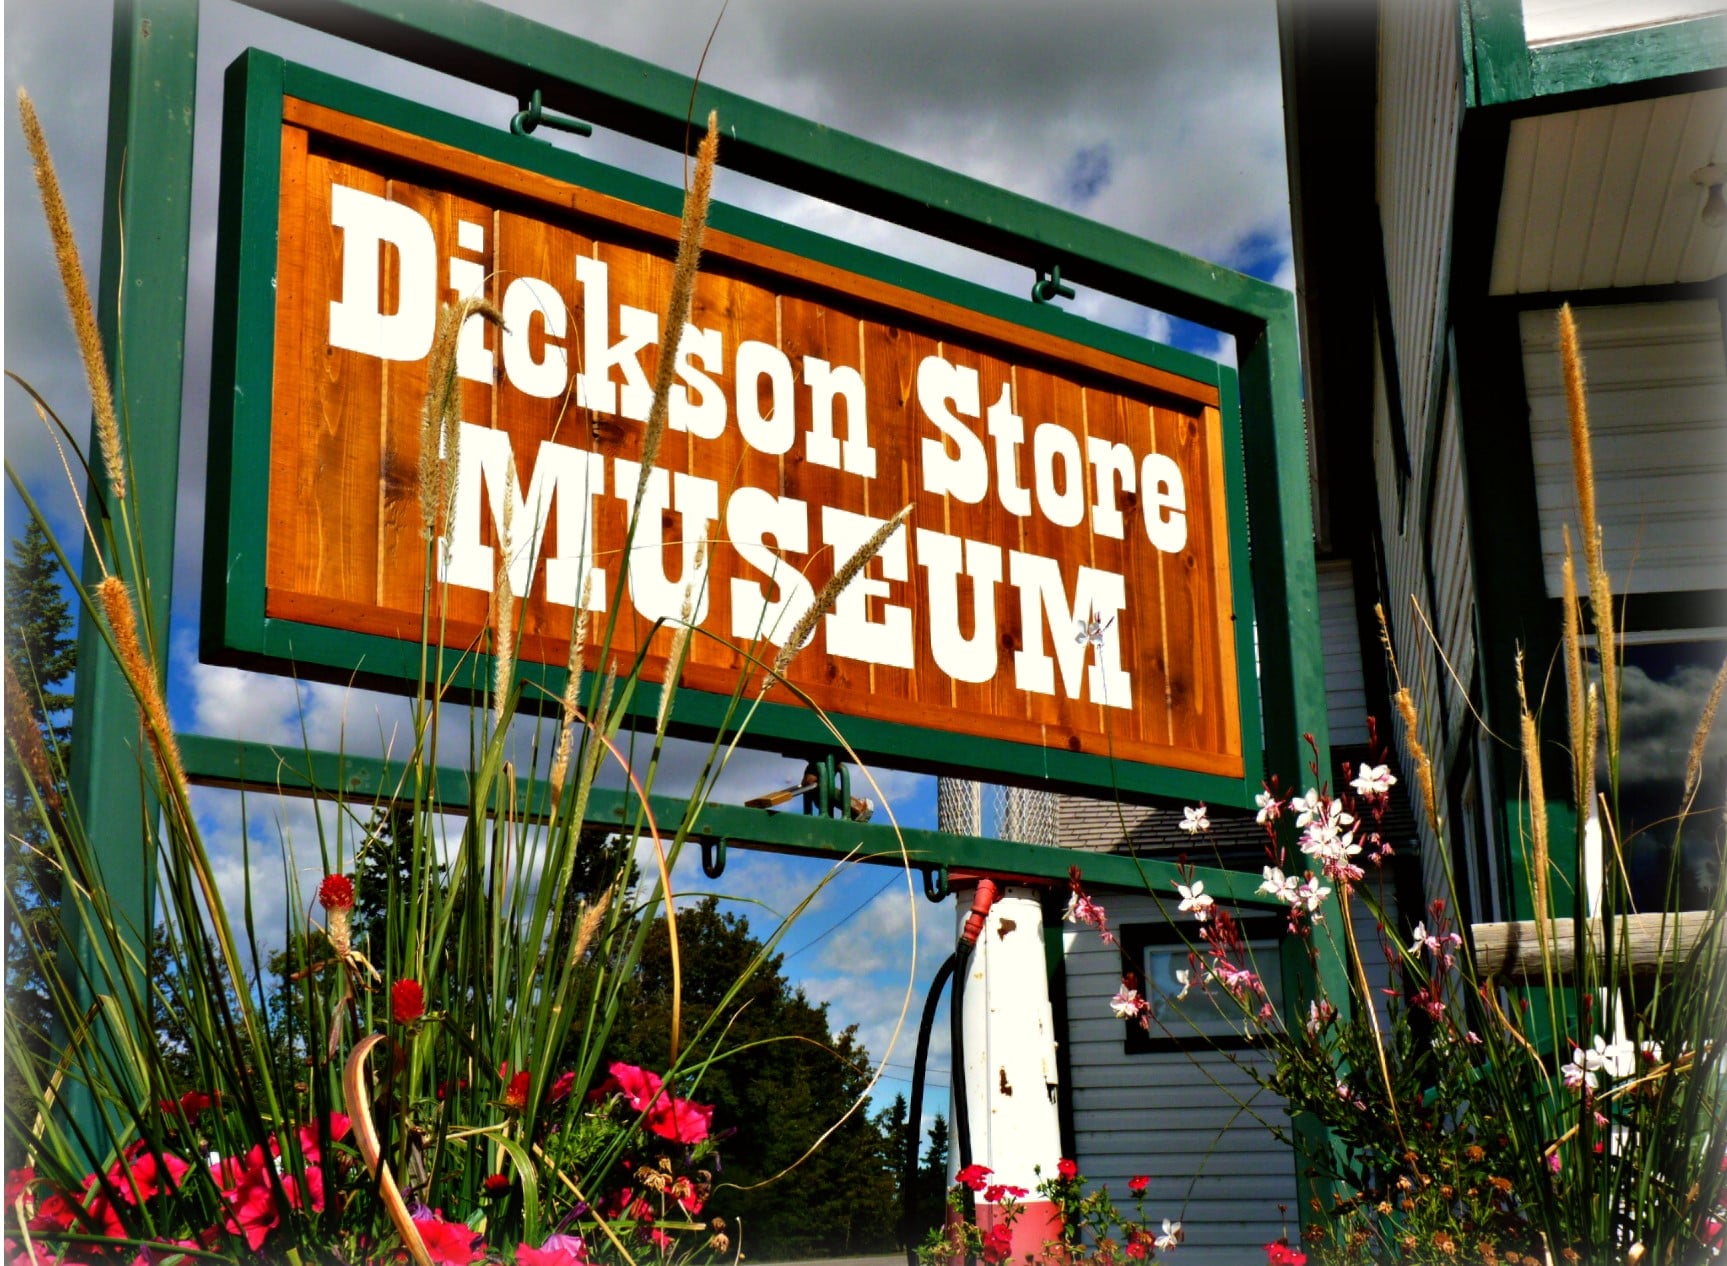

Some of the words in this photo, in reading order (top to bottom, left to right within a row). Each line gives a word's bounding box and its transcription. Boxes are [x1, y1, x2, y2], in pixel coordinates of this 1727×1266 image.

[329, 183, 876, 479] Dickson
[917, 356, 1187, 553] Store
[437, 420, 1132, 709] MUSEUM
